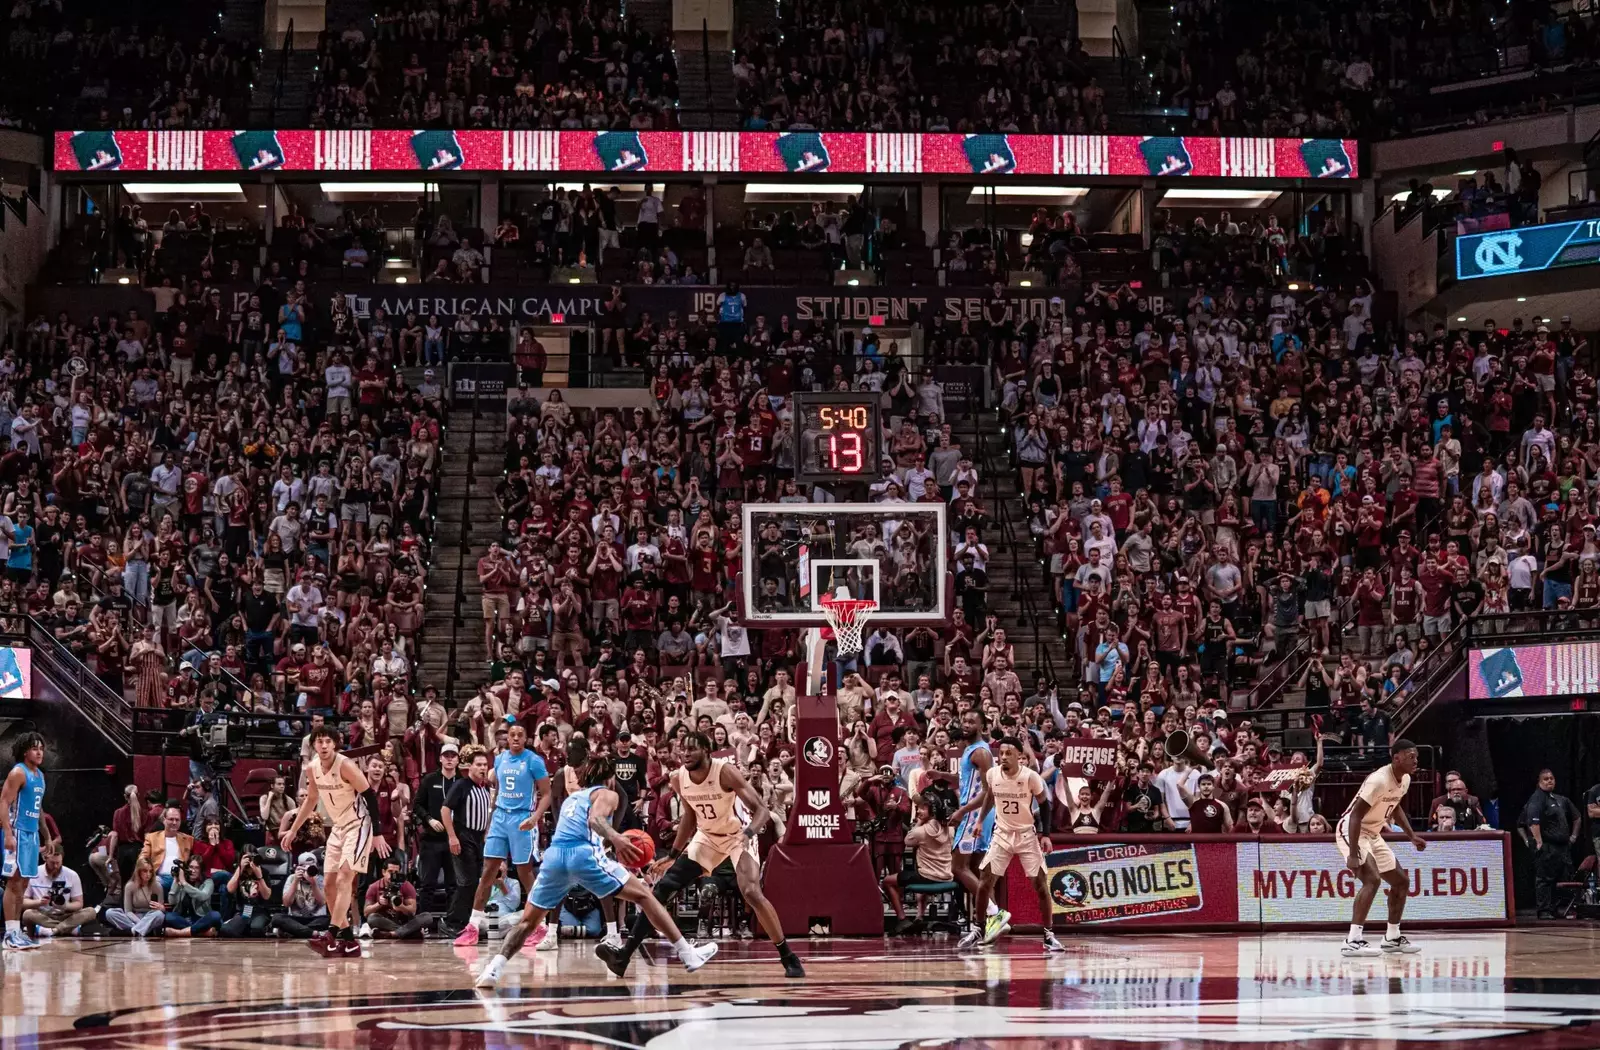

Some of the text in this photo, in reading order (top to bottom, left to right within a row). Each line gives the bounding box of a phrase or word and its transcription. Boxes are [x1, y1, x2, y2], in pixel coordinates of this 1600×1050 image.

[380, 298, 604, 316] AMERICAN CAMPU
[694, 293, 715, 312] 119
[820, 407, 867, 429] 5:40
[750, 437, 762, 451] 13
[830, 433, 862, 471] 13
[1066, 746, 1115, 766] DEFENSE
[506, 777, 515, 790] 5
[34, 796, 41, 810] 2
[696, 804, 717, 819] 33
[1002, 801, 1019, 814] 23
[798, 815, 840, 827] MUSCLE
[806, 827, 834, 838] MILK
[1088, 844, 1148, 862] FLORIDA
[1090, 859, 1193, 900] GO NOLES
[1253, 867, 1489, 898] MYTAGU.EDU
[1066, 898, 1188, 923] NATIONAL CHAMPIONS
